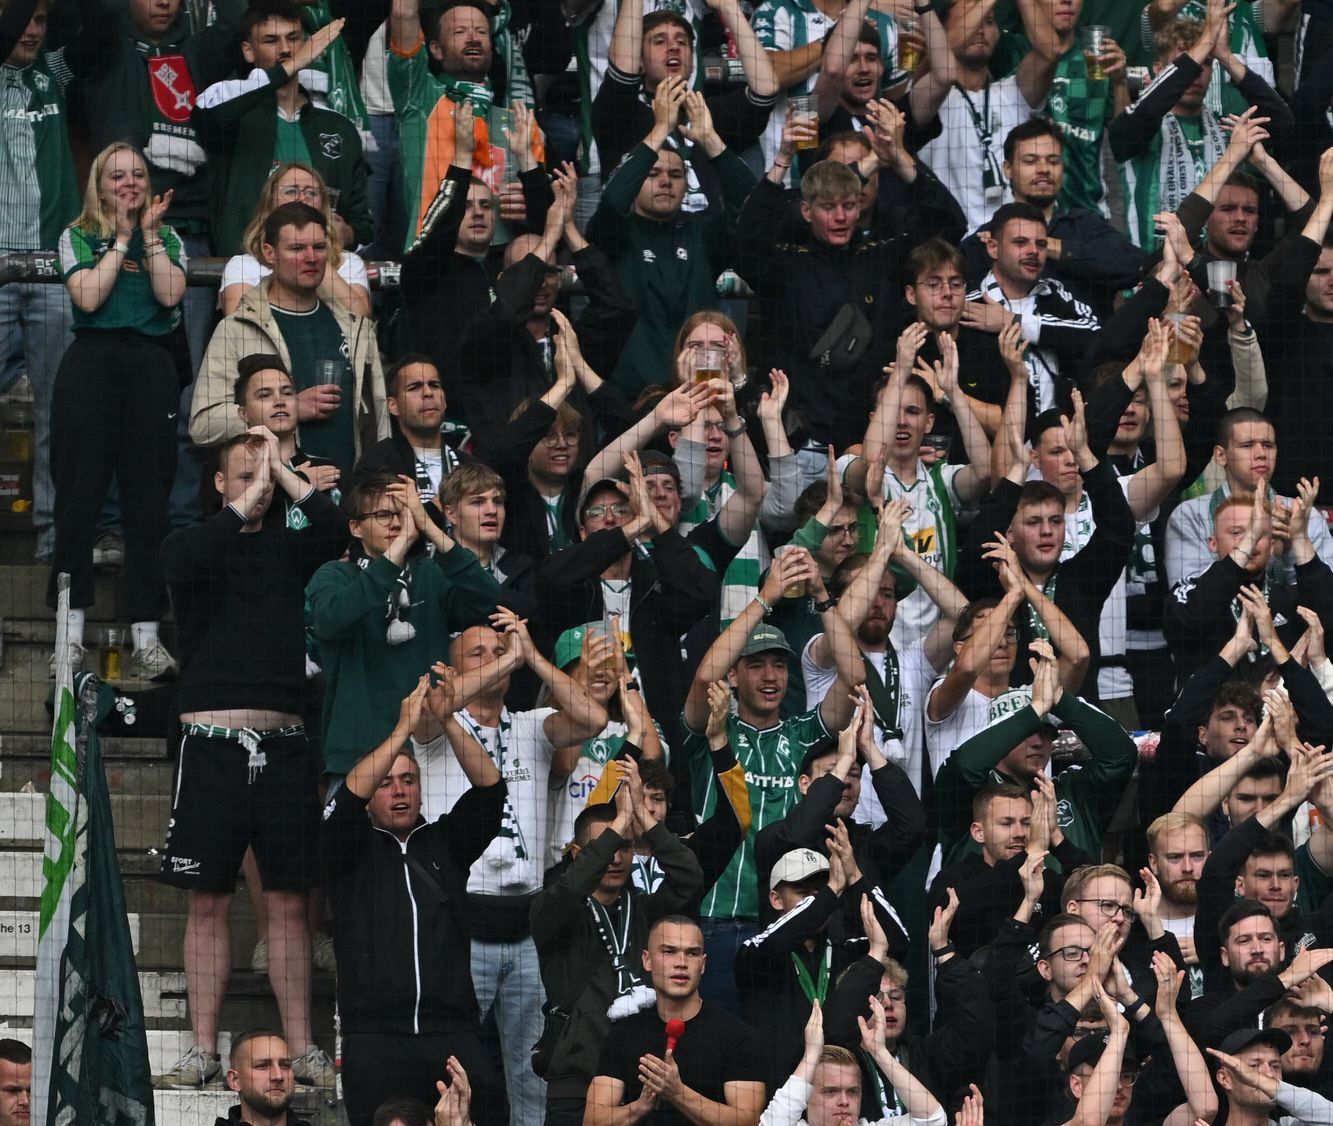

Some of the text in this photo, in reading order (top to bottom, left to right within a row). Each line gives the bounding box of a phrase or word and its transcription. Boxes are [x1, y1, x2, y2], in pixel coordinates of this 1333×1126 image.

[153, 121, 197, 136] BREMEN
[171, 857, 192, 867] SPORT
[18, 924, 31, 933] 13
